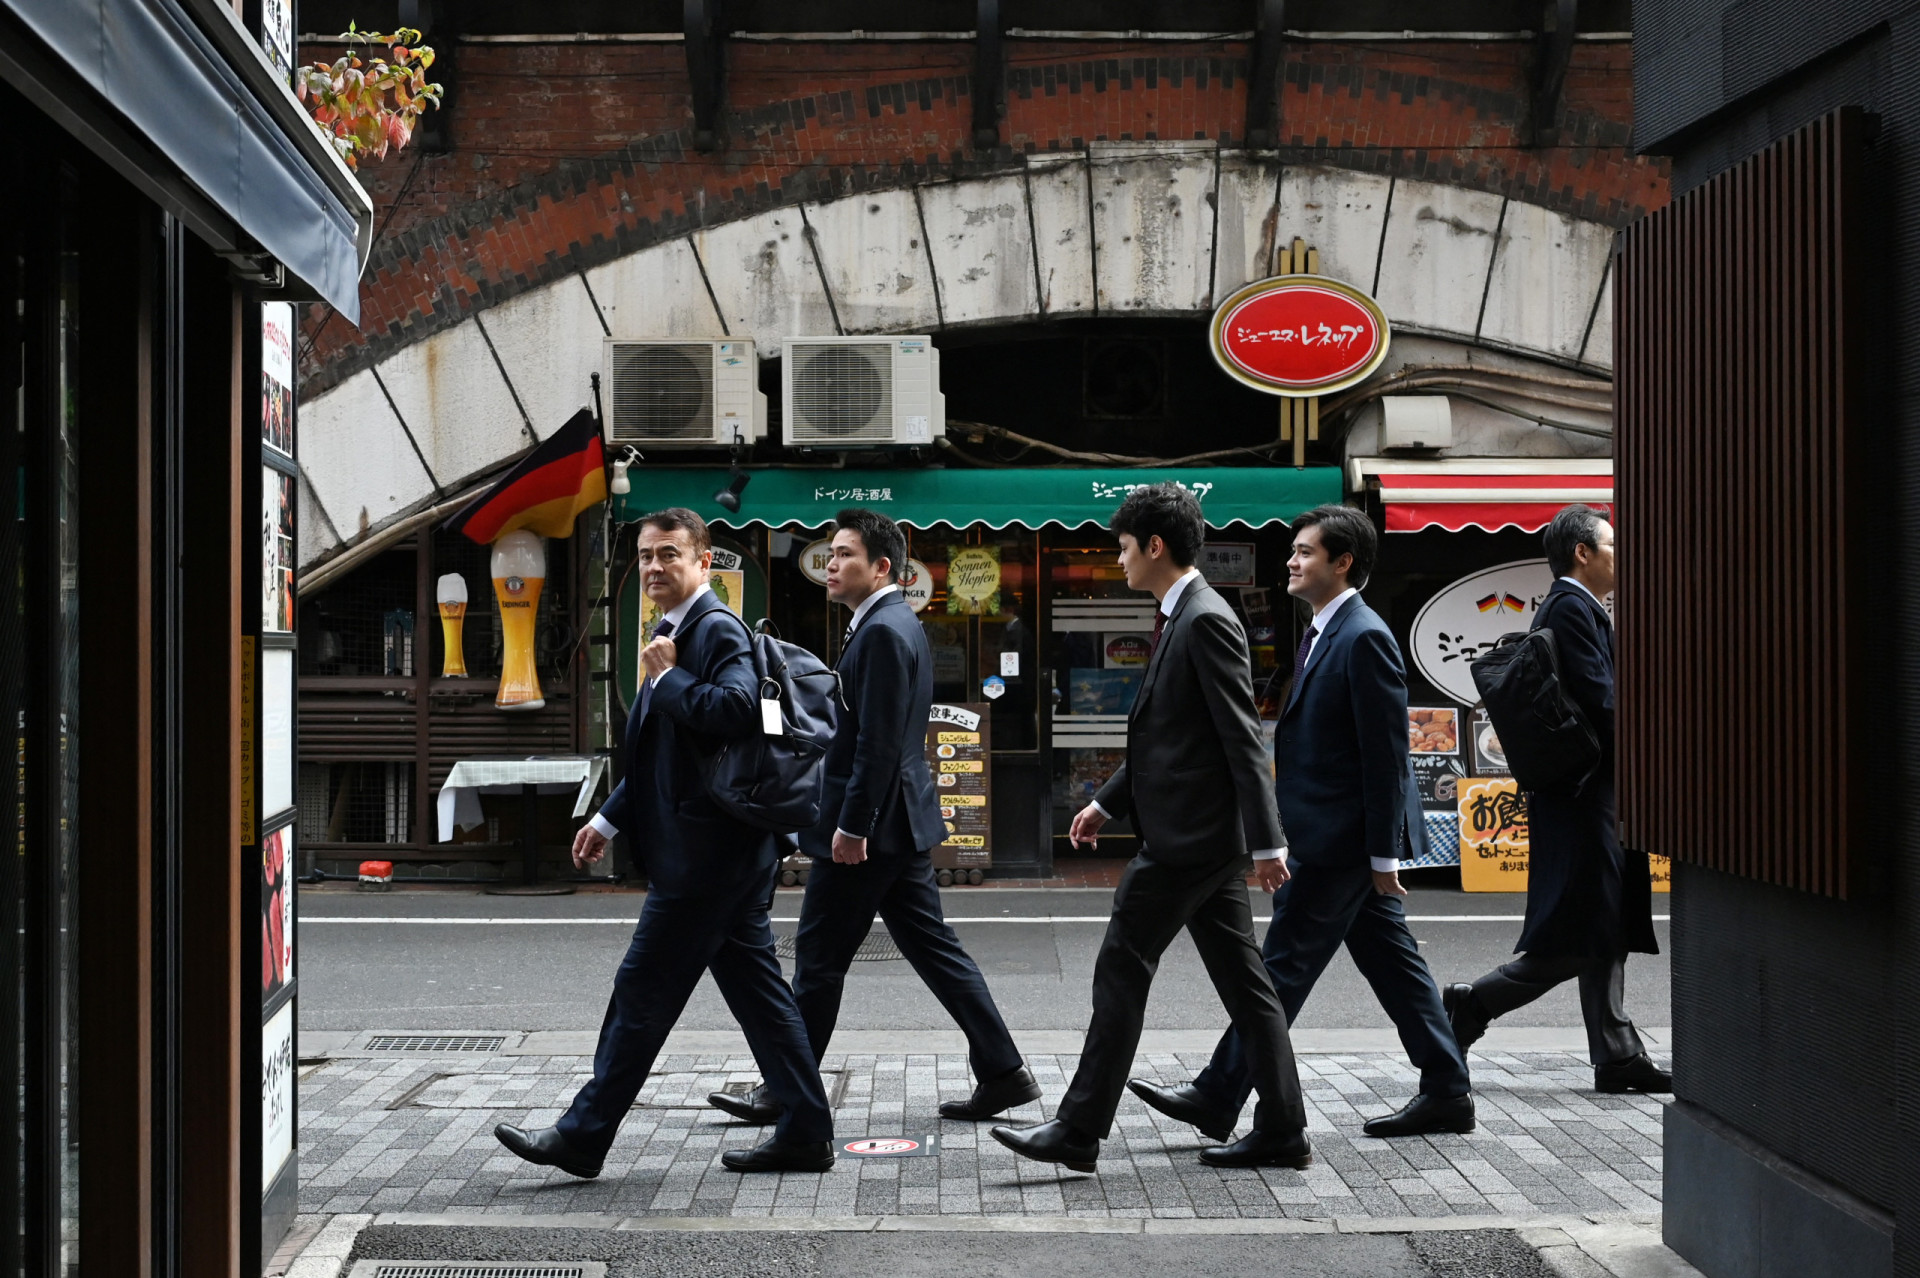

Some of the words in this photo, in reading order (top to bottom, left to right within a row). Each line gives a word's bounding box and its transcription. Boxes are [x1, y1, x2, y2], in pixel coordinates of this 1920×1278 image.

[814, 486, 893, 501] ドイツ居酒屋
[812, 553, 831, 570] Bi
[1206, 551, 1242, 565] 準備中
[951, 559, 992, 573] Sonnen
[958, 571, 996, 589] Hopfen
[902, 590, 926, 598] INGER
[1511, 828, 1529, 841] メニ
